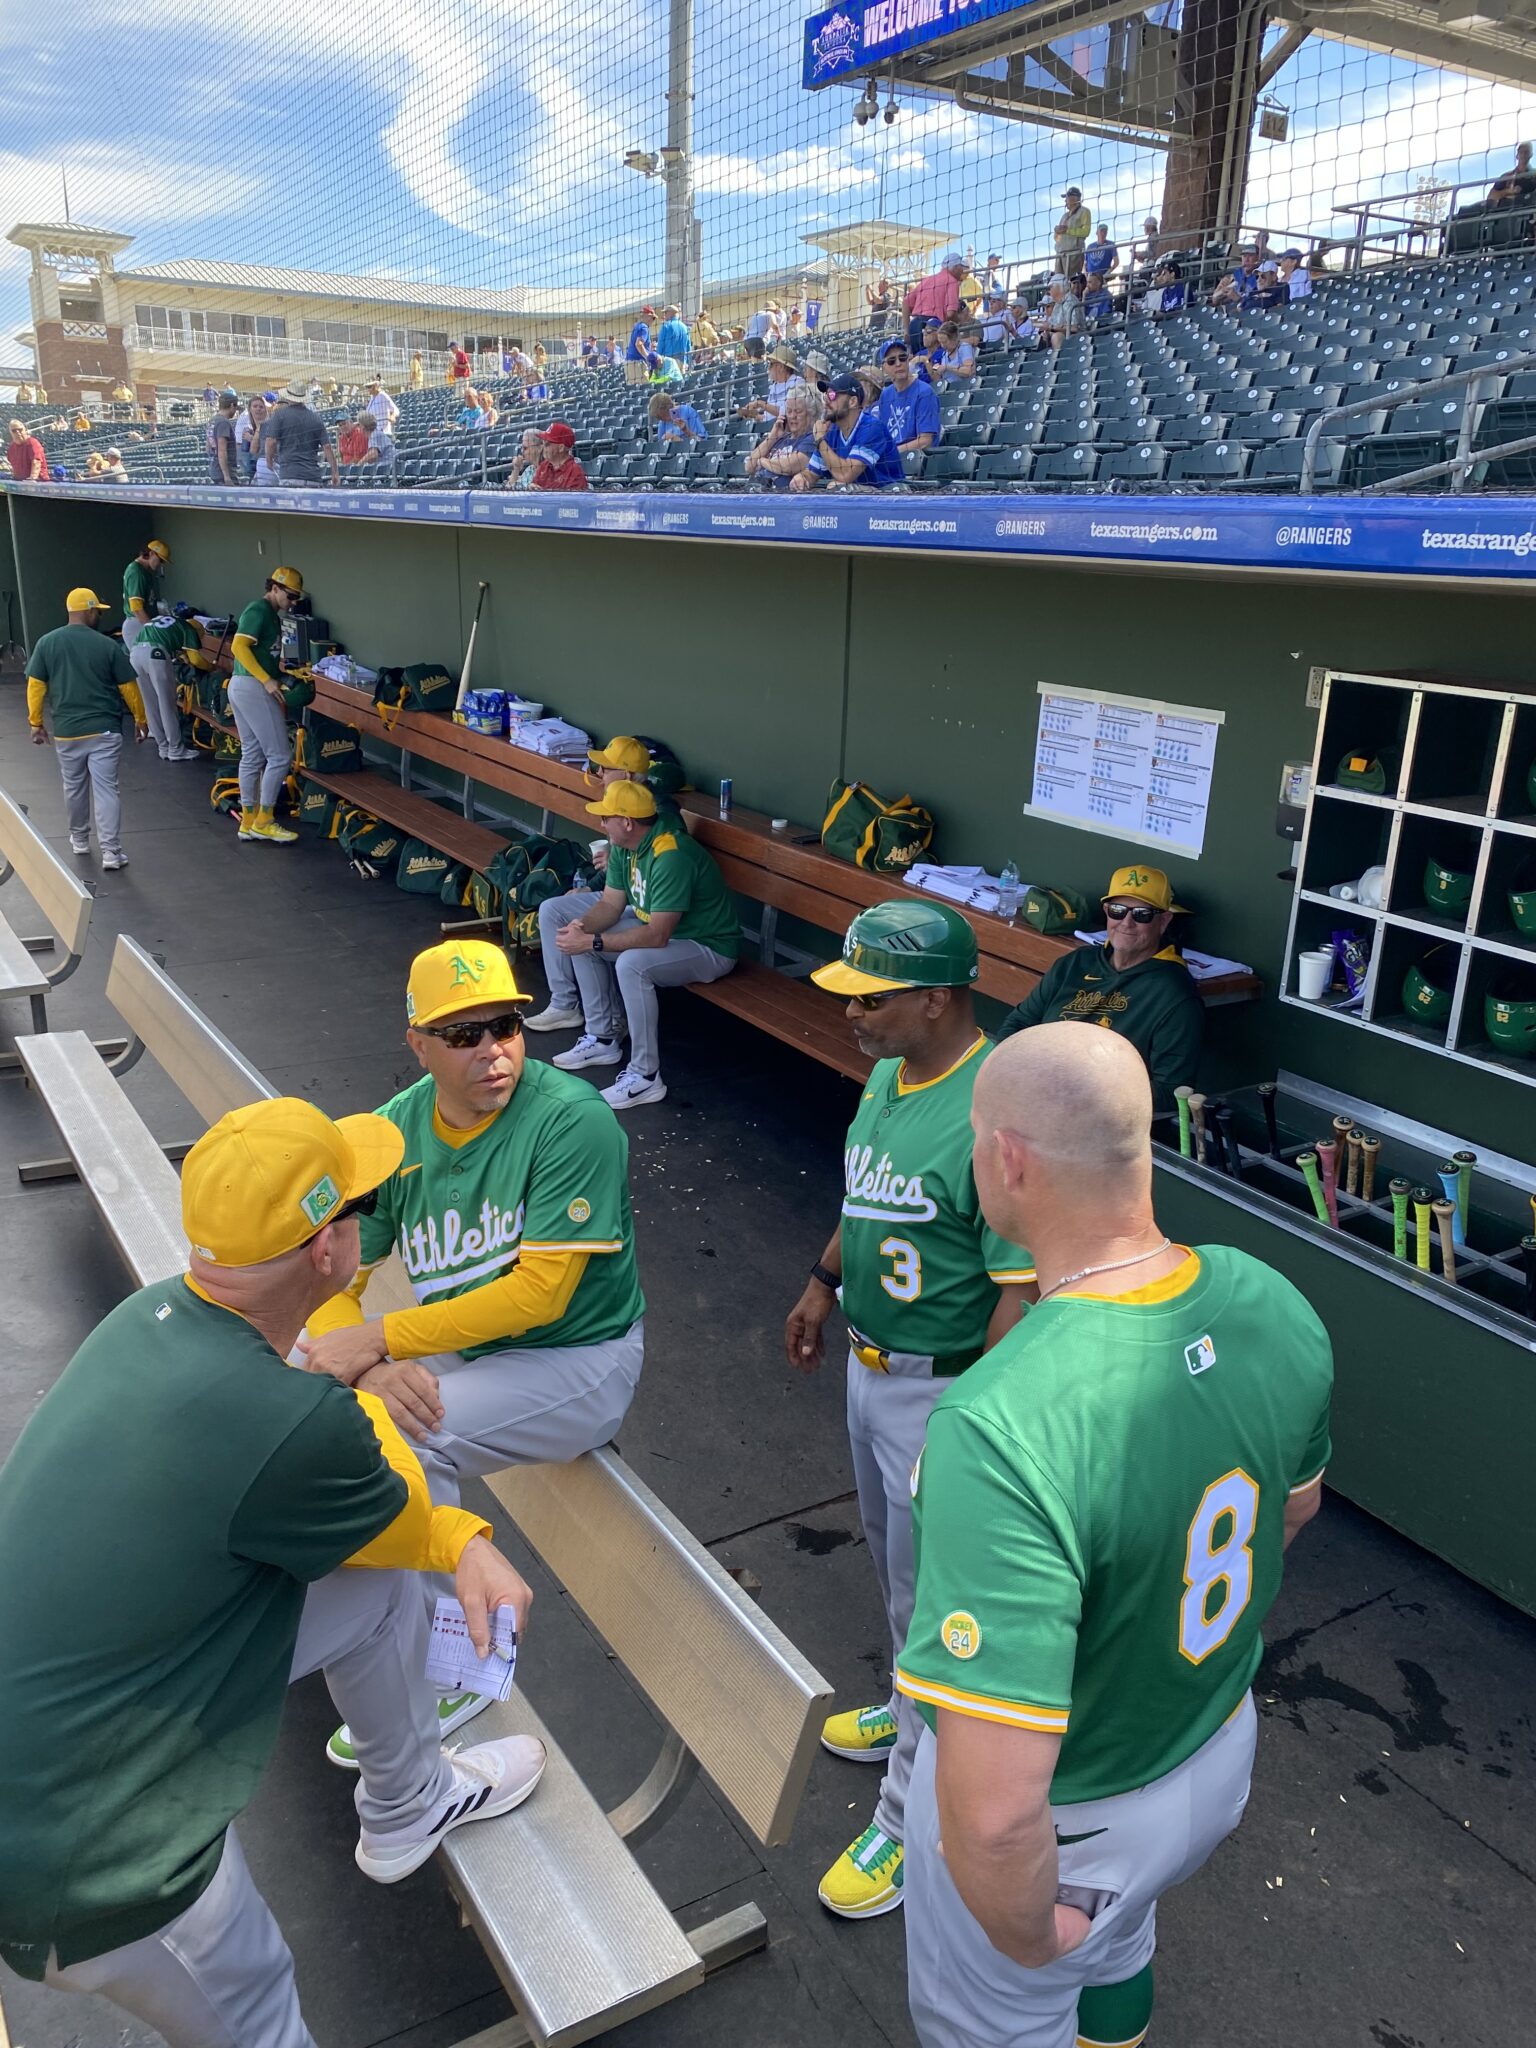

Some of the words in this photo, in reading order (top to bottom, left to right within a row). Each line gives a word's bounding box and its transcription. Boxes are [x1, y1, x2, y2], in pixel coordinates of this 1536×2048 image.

[711, 513, 776, 529] texasrangers.com
[802, 515, 838, 530] @RANGERS
[869, 517, 957, 534] texasrangers.com
[995, 519, 1045, 537] @RANGERS
[1090, 521, 1218, 543] texasrangers.com
[1276, 526, 1351, 547] @RANGERS
[1122, 869, 1149, 887] A's
[450, 954, 486, 989] A's
[879, 1236, 922, 1302] 3
[1178, 1467, 1260, 1666] 8
[950, 1629, 971, 1652] 24
